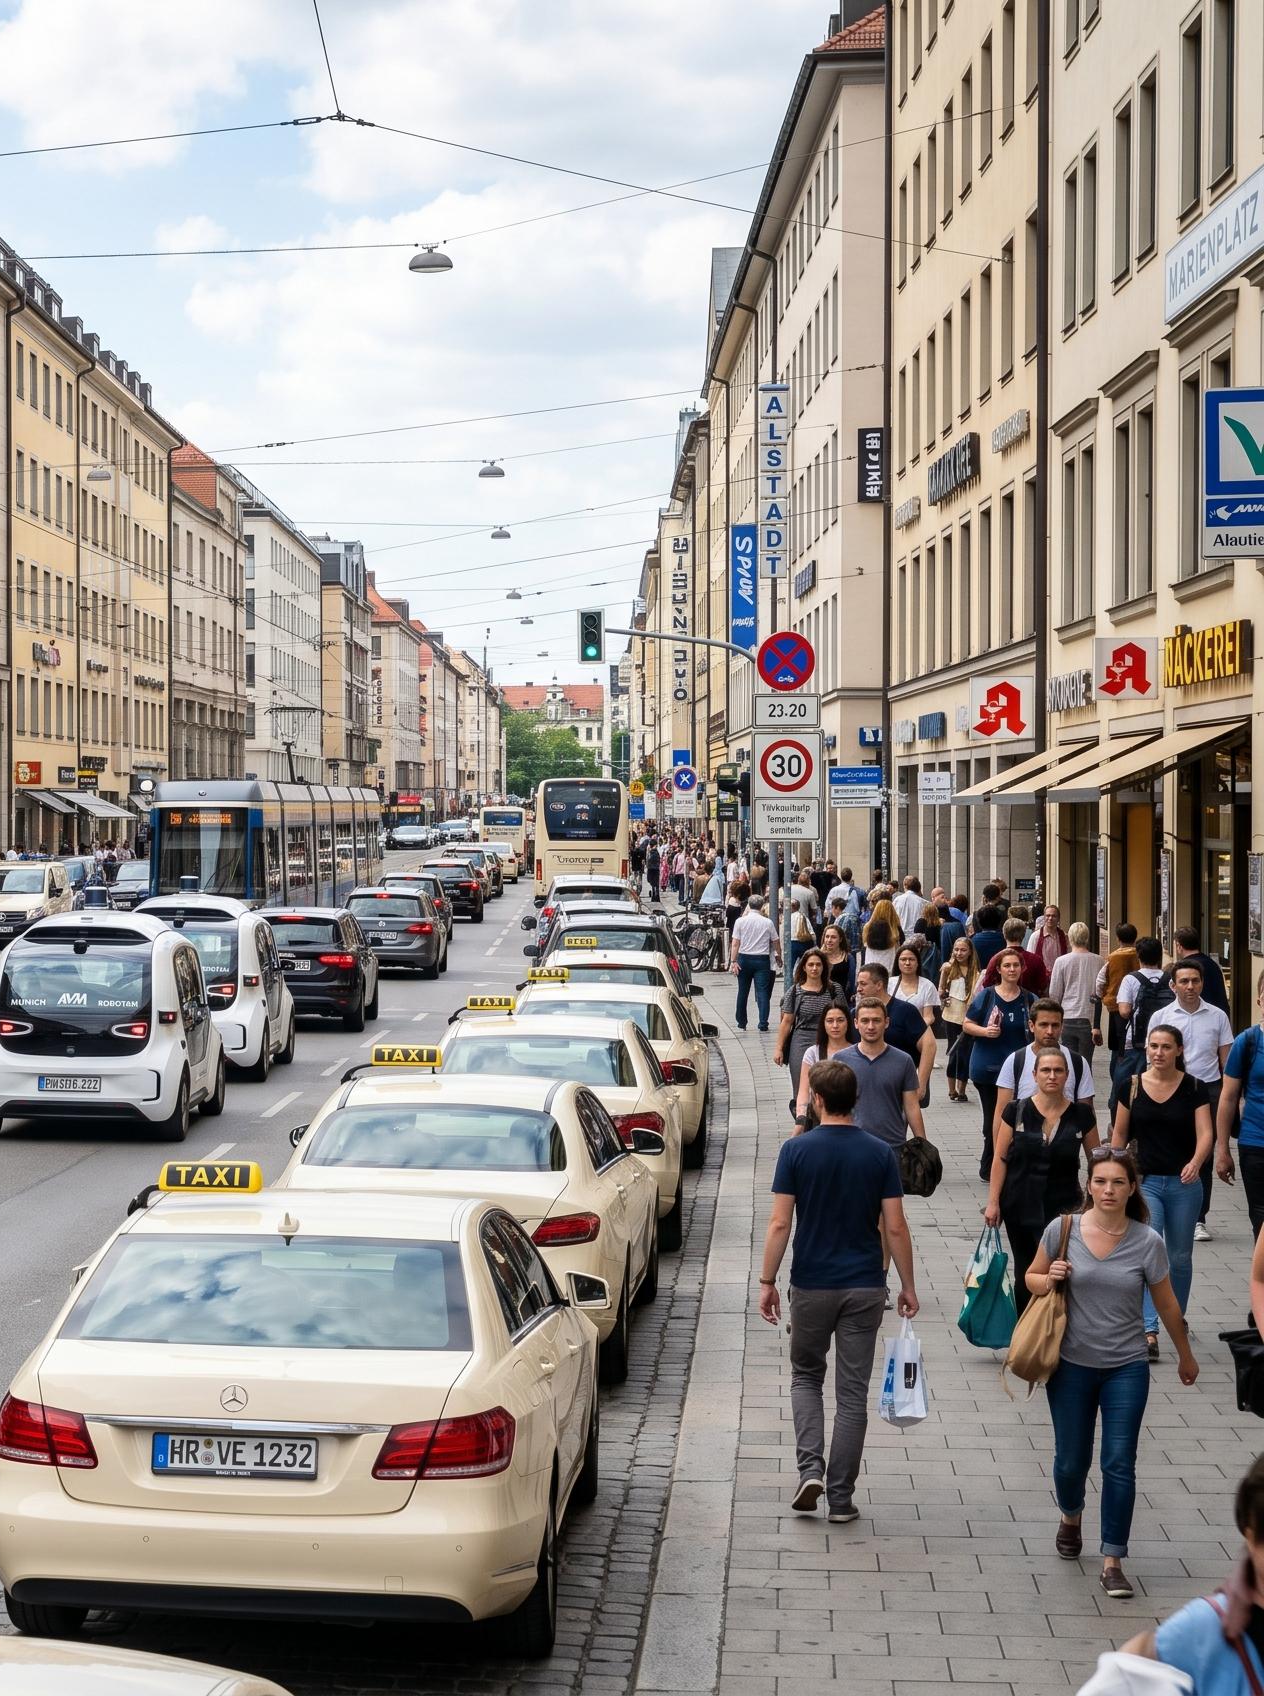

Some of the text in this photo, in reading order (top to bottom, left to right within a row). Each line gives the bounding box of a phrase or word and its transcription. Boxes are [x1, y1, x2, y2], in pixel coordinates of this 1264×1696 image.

[1169, 190, 1259, 303] MARIENPLATZ
[765, 395, 784, 575] ALSTADT
[771, 754, 802, 778] 30
[57, 992, 87, 1005] AVM
[476, 998, 505, 1006] TAXI
[381, 1049, 429, 1062] TAXI
[176, 1166, 241, 1186] TAXI
[170, 1439, 313, 1468] HR VE 1232
